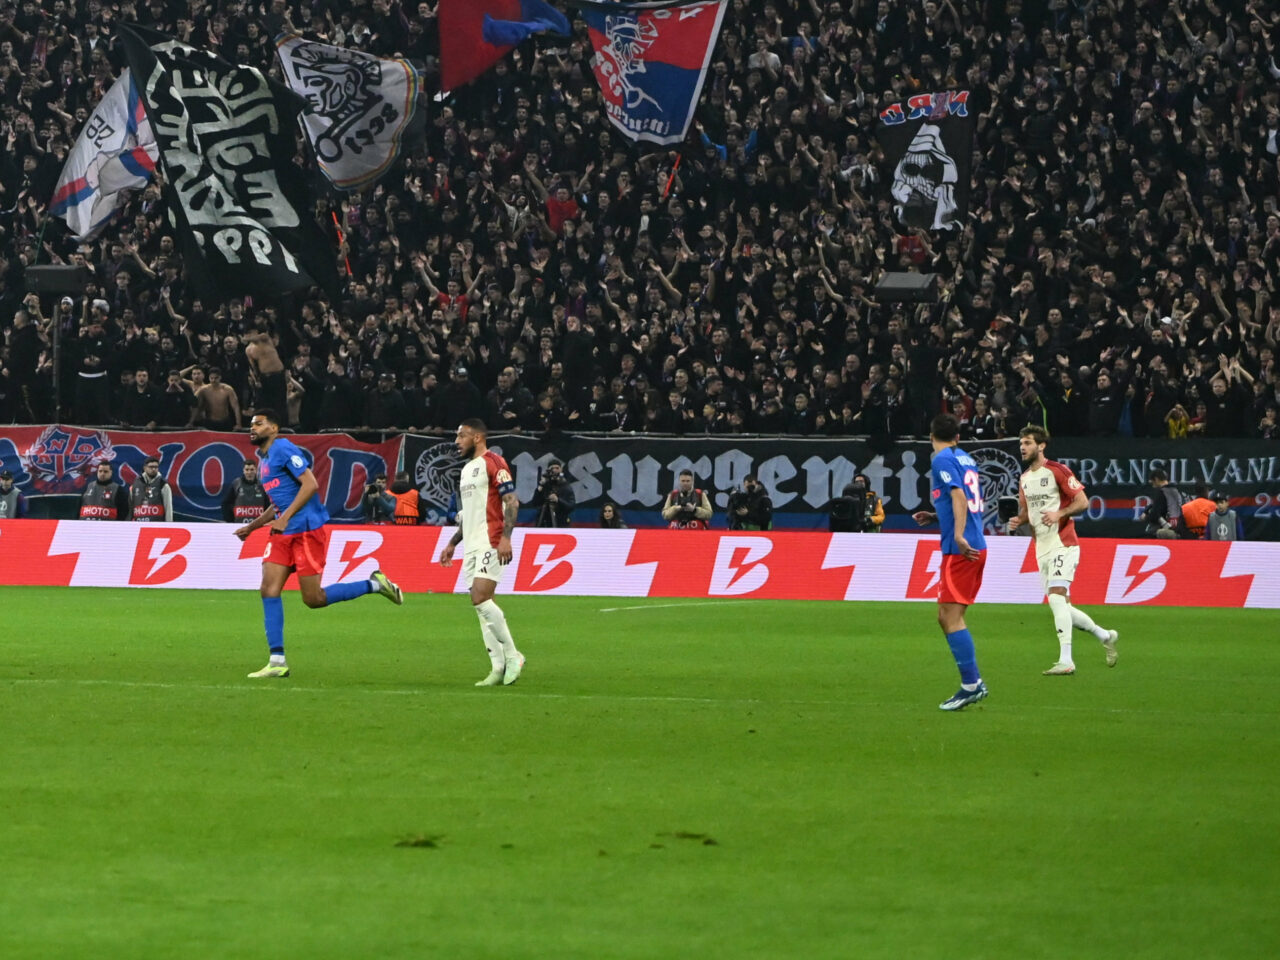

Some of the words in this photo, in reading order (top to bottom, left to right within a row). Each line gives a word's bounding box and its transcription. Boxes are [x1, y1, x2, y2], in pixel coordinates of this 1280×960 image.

[104, 442, 388, 520] NOD
[964, 470, 985, 514] 3
[482, 551, 492, 566] 8
